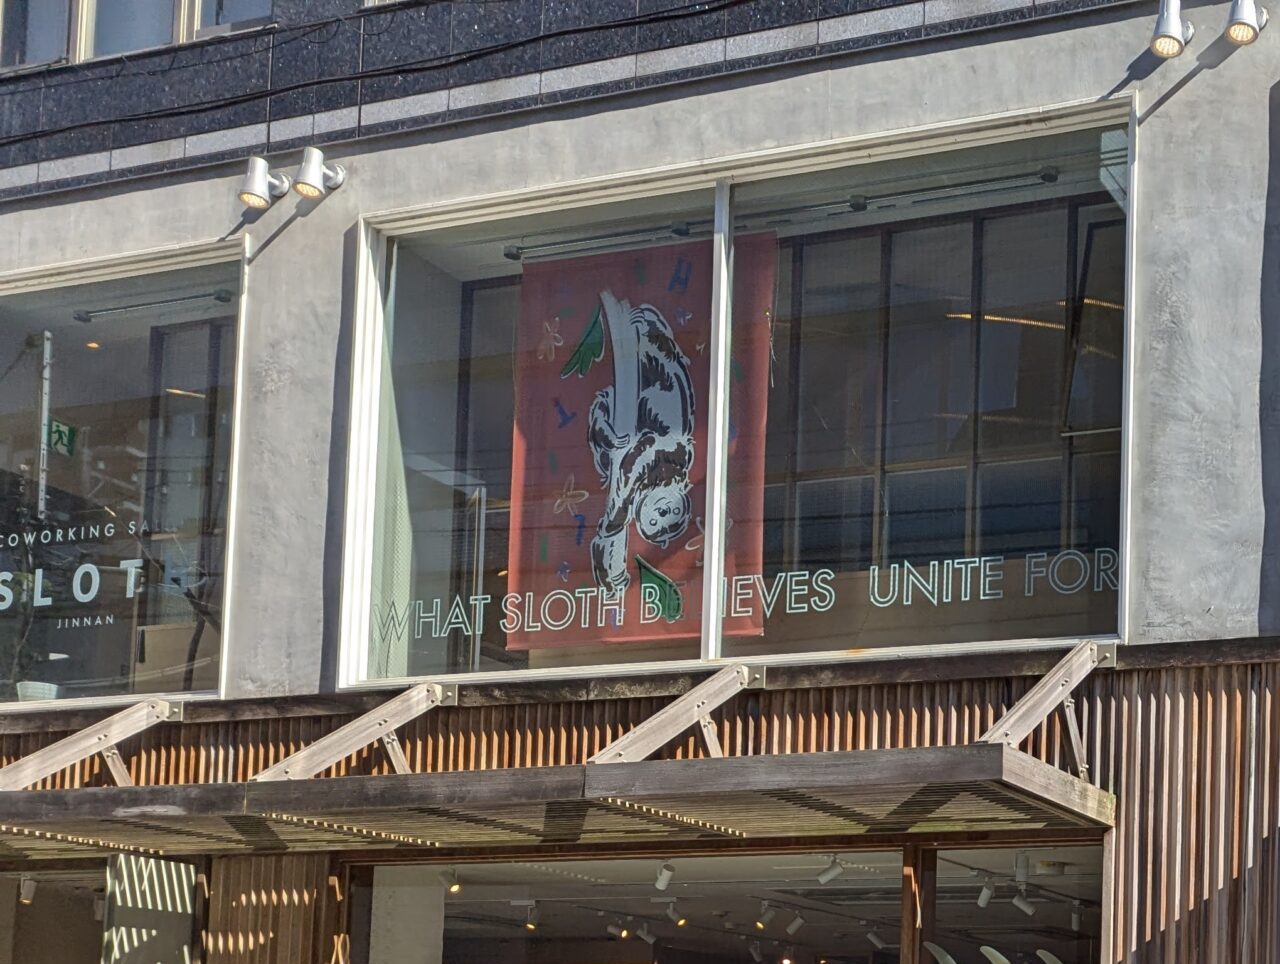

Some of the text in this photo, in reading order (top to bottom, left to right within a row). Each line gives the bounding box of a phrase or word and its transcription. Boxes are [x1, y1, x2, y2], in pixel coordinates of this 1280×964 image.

[57, 614, 114, 630] JINNAN
[373, 594, 491, 643] WHAT
[500, 586, 625, 634] SLOTH
[869, 555, 1004, 607] UNITE
[1024, 547, 1119, 597] FOR
